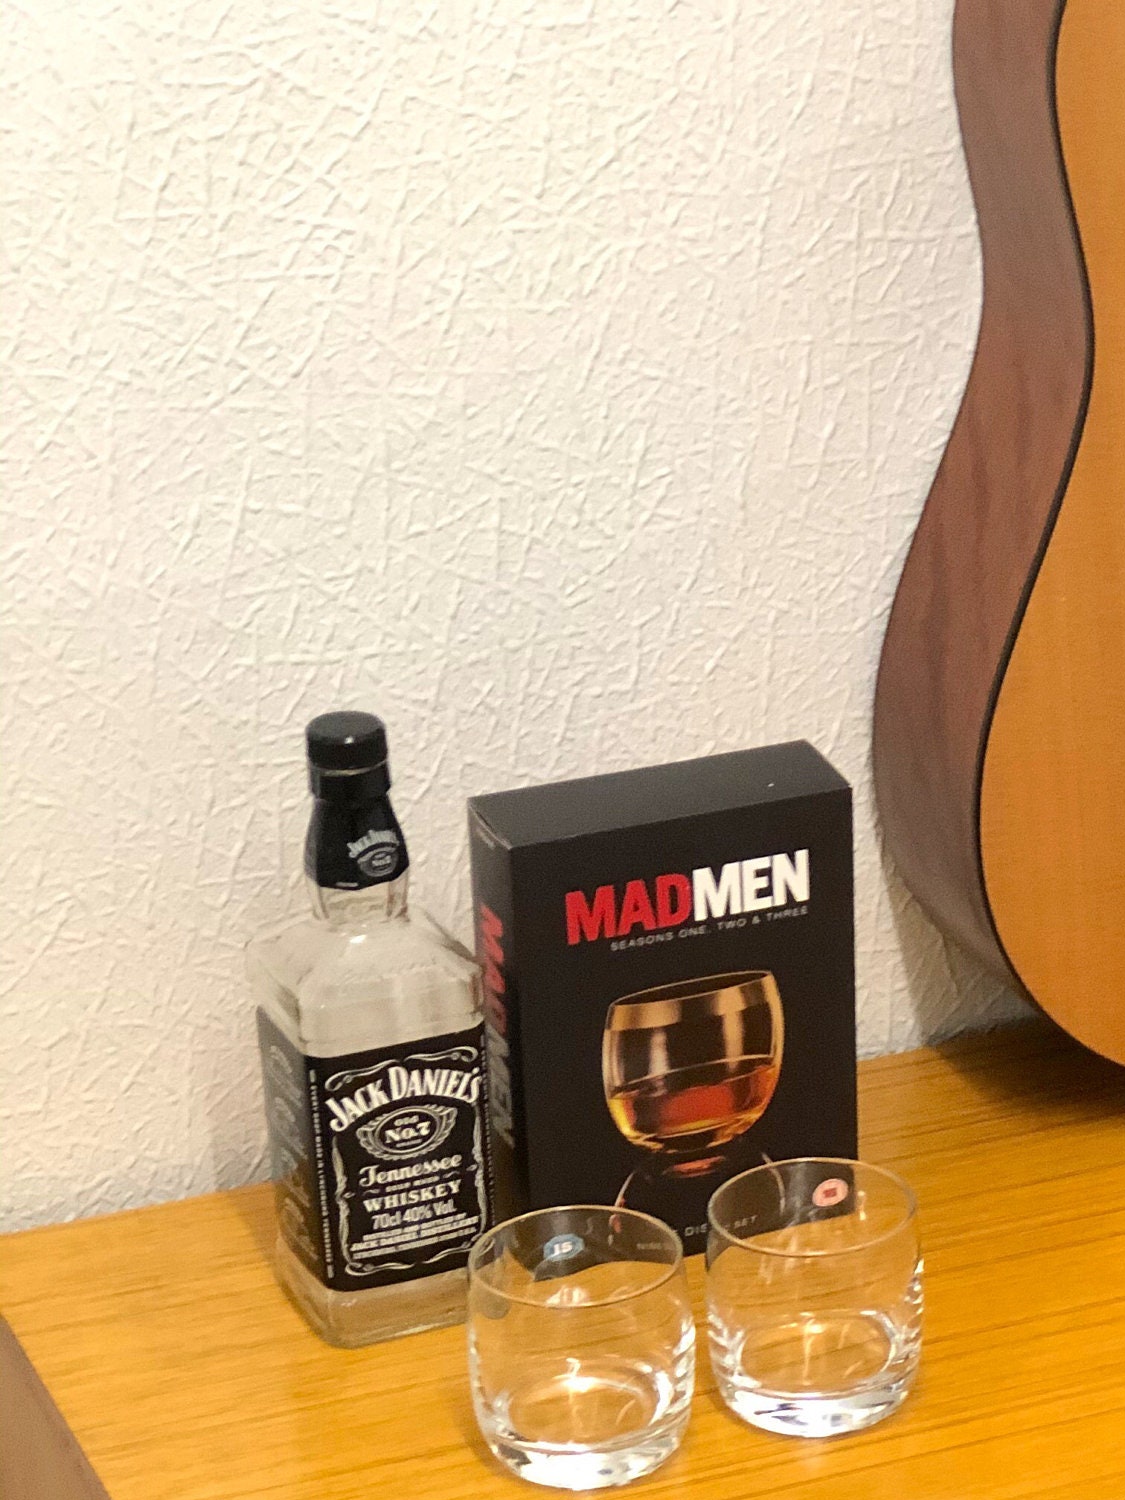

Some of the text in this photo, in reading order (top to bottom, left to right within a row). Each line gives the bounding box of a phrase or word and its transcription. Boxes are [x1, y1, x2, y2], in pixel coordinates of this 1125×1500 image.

[610, 931, 674, 951] SEASONS
[716, 918, 748, 931] TWO
[751, 916, 762, 925] &
[766, 905, 809, 921] THREE
[325, 1066, 483, 1132] JACK DANIEL'S
[359, 1154, 463, 1188] Tennessee
[363, 1179, 462, 1213] WHISKEY
[371, 1209, 402, 1230] 70cl
